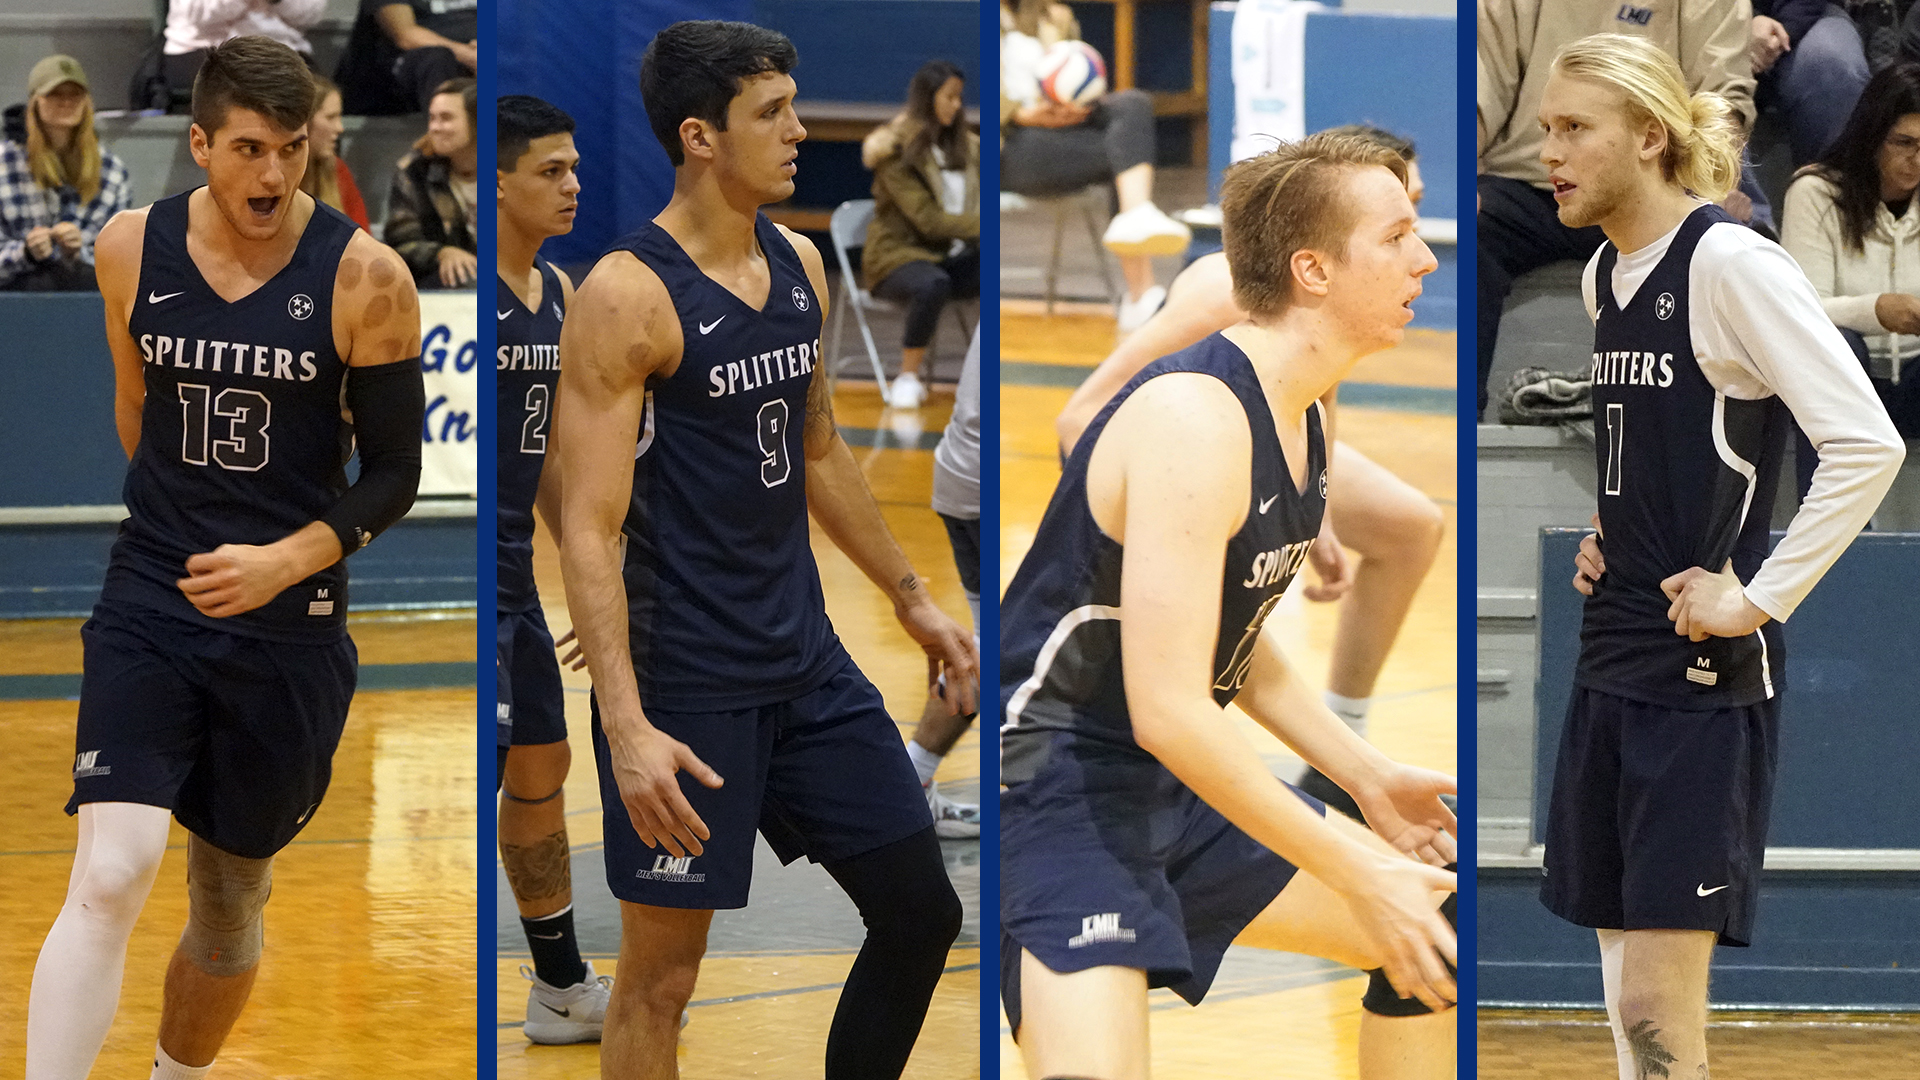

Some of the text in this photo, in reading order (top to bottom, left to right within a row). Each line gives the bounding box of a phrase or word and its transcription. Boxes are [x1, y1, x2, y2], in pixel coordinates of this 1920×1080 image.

[140, 334, 317, 382] SPLITTERS
[421, 324, 477, 373] Go
[497, 345, 562, 370] SPLITTE
[1591, 351, 1674, 388] PLITTERS
[177, 382, 271, 472] 13
[520, 384, 549, 454] 2
[756, 398, 791, 488] 9
[1605, 403, 1623, 495] 1
[317, 588, 329, 599] M
[1697, 656, 1710, 668] M
[635, 869, 706, 883] MEN'S VOLLEYBALL
[652, 854, 696, 874] LMU
[1082, 913, 1121, 936] LMU
